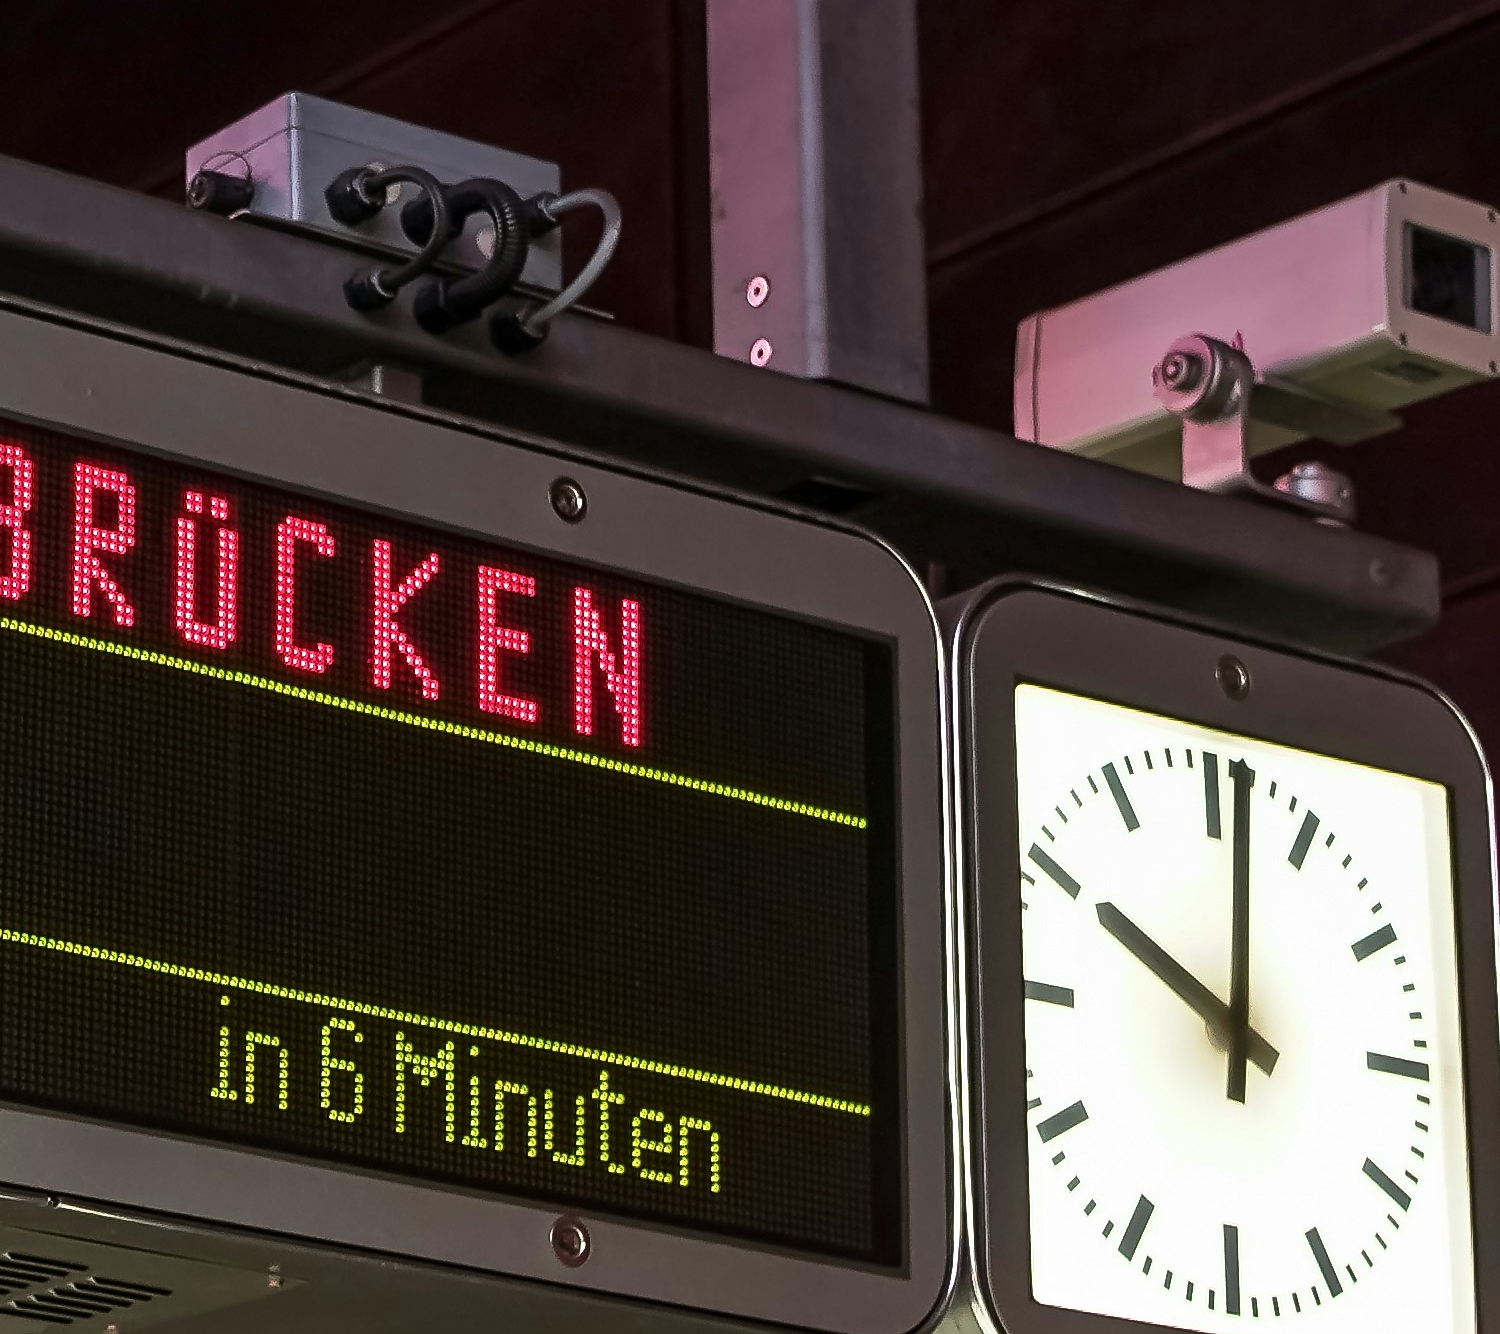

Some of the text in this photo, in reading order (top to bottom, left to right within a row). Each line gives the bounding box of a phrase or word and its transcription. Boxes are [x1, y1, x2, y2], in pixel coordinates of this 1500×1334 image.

[210, 993, 721, 1194] in 6 Minuten
